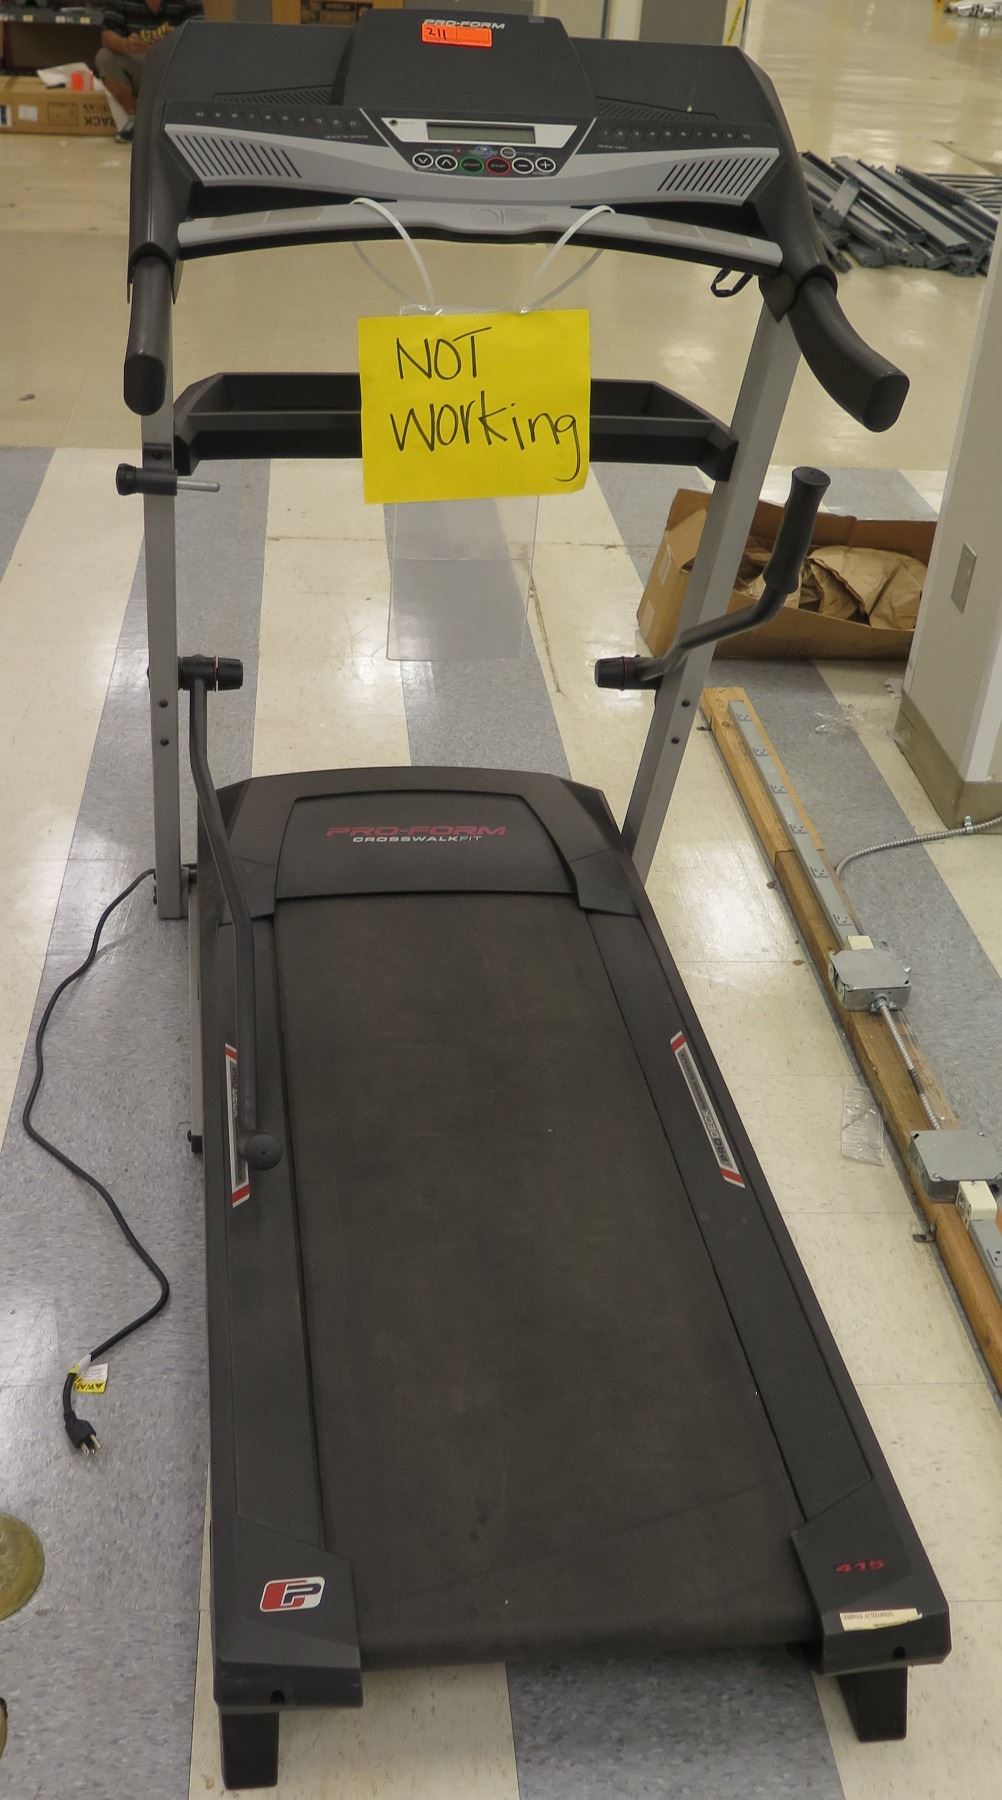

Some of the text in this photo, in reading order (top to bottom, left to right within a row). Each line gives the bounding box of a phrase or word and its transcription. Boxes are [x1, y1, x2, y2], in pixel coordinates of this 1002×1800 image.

[396, 326, 492, 380] NOT
[326, 826, 507, 836] PRO-FORM
[835, 1560, 884, 1573] 415
